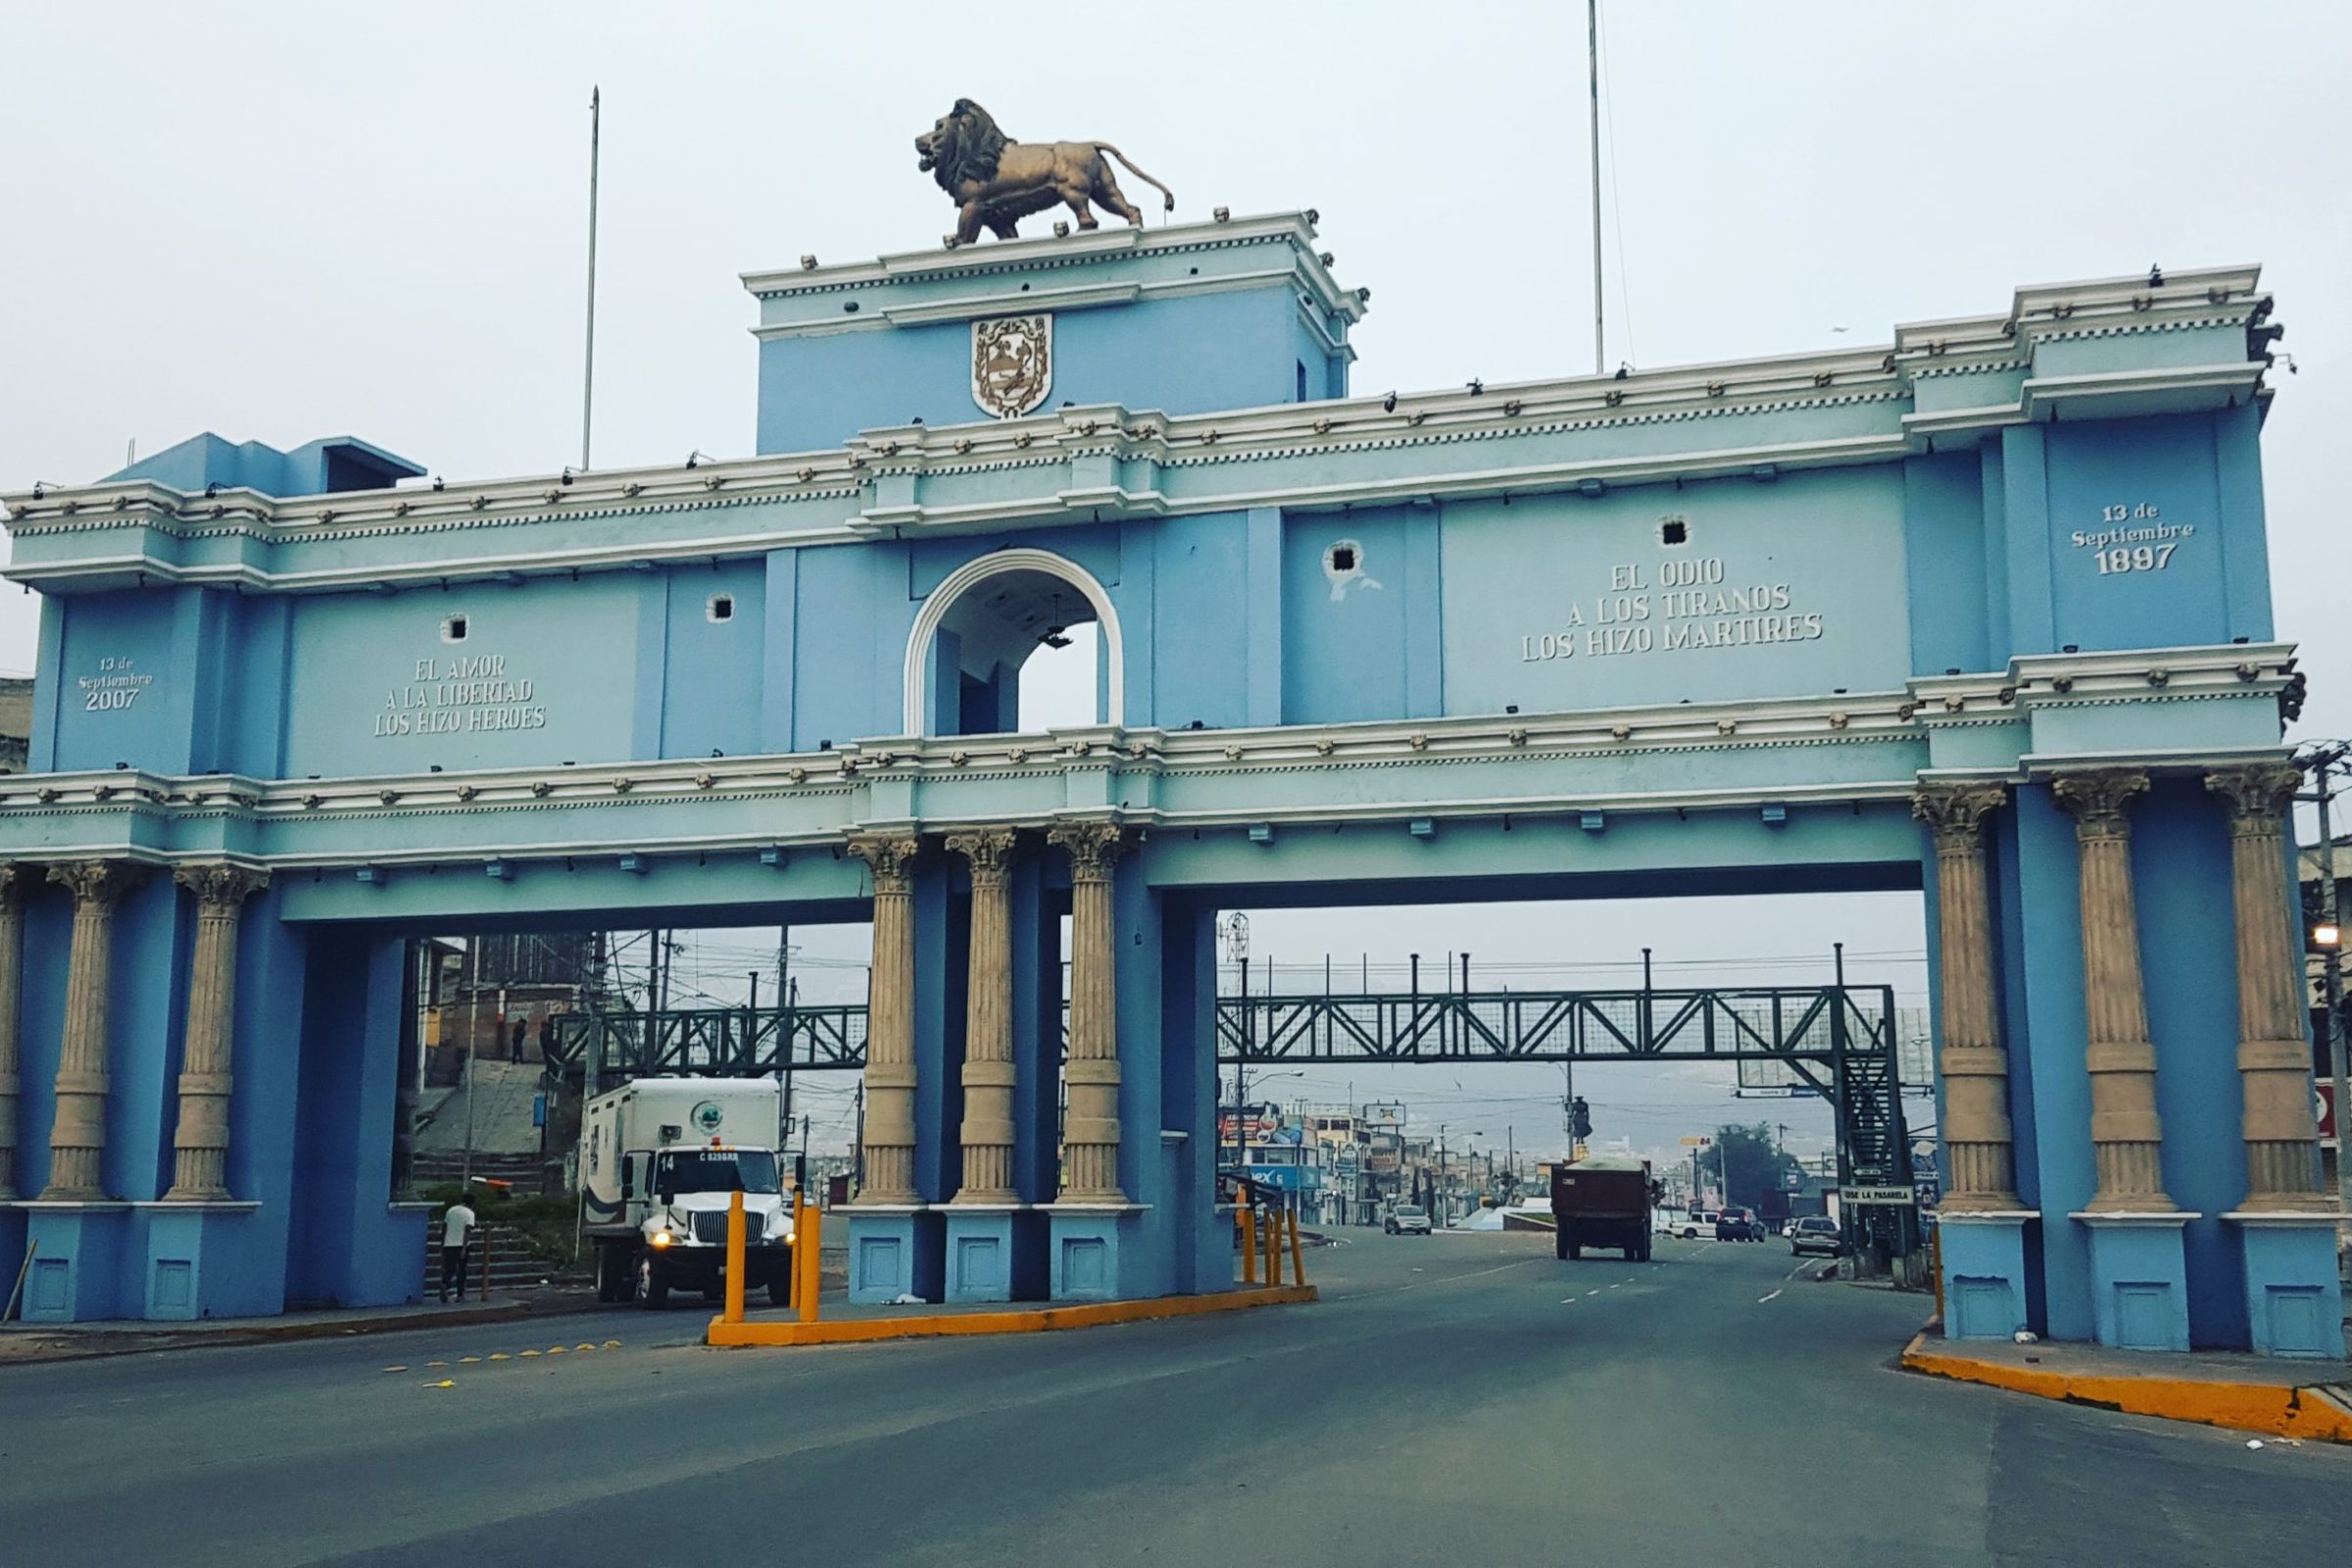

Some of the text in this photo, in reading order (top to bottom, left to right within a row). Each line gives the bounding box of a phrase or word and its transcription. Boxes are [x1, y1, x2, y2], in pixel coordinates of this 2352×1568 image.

[2102, 502, 2159, 521] 13 de
[2071, 522, 2195, 549] Septiembre
[2094, 543, 2178, 575] 1897
[1609, 557, 1724, 592] EL ODIO
[1567, 584, 1790, 627] A LOS TIRANOS
[1521, 614, 1823, 662] LOS HIZO MARTIRES
[100, 656, 133, 670] 13 de
[415, 655, 506, 682] EL AMOR
[78, 673, 153, 691] Septiembre
[386, 678, 533, 710] A LA LIBERTAD
[85, 688, 139, 711] 2007
[374, 706, 546, 737] LOS HIZO HEROES
[661, 1154, 674, 1171] 14
[1861, 1191, 1871, 1200] LA
